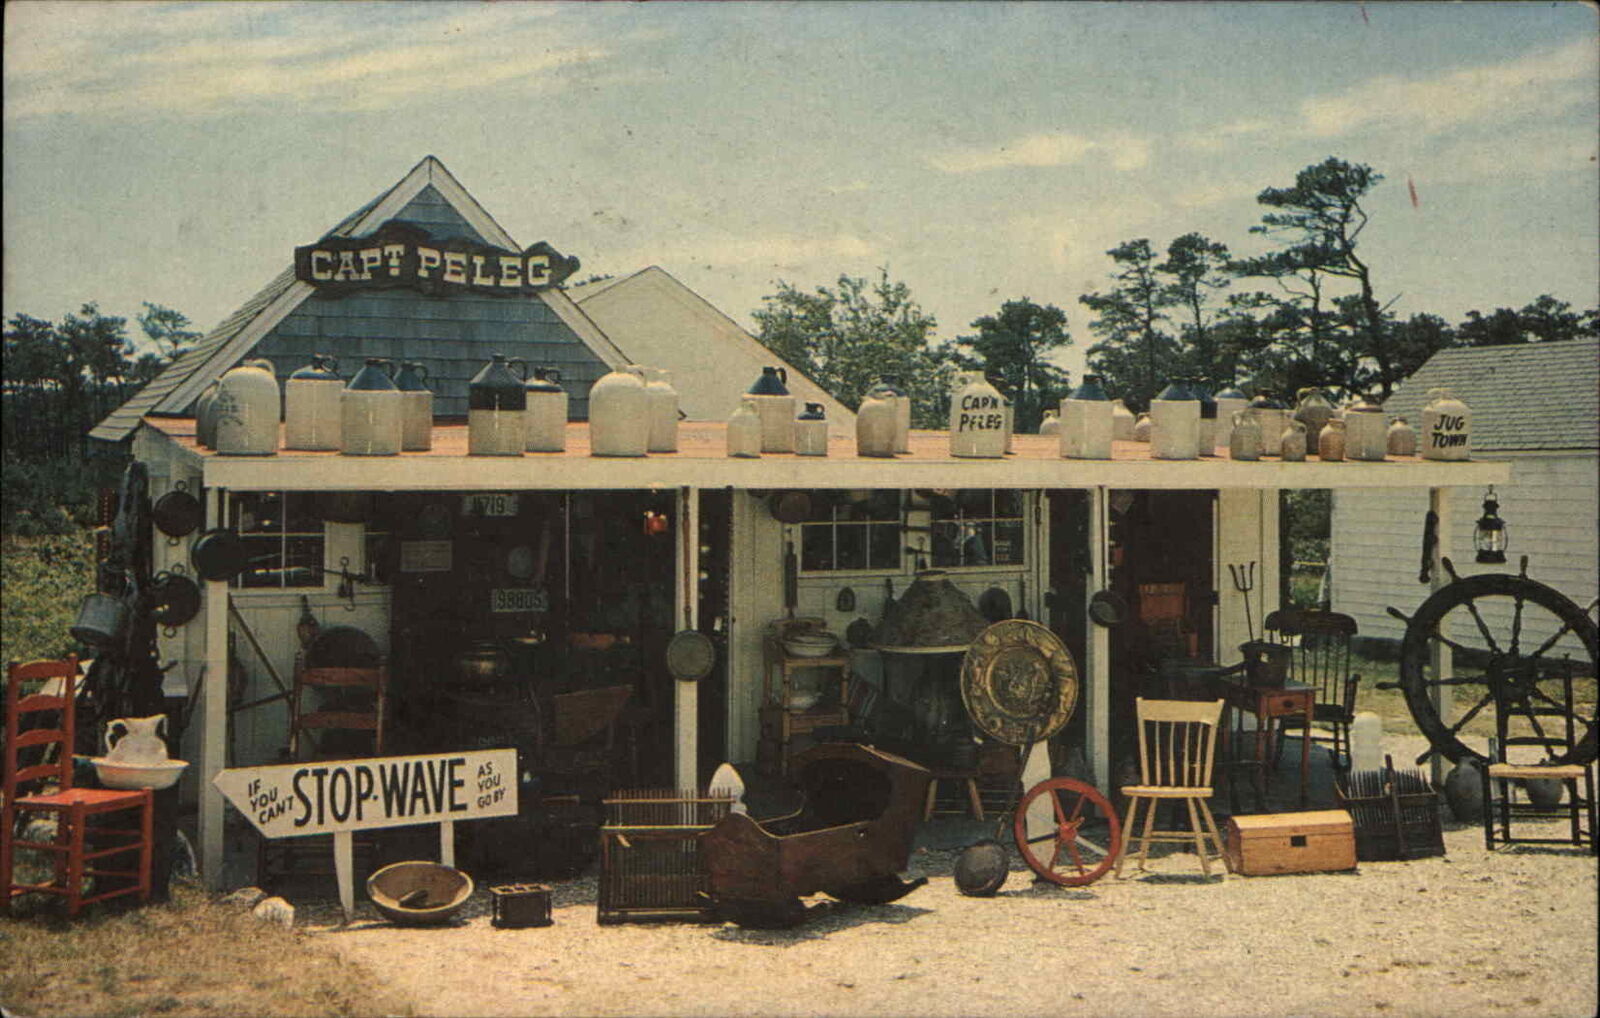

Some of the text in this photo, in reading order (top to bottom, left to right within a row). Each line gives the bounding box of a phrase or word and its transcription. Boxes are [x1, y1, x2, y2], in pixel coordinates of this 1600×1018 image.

[417, 246, 551, 287] PELEG
[1434, 414, 1465, 431] JUG
[1432, 432, 1468, 448] TOWN
[478, 761, 493, 778] AS
[248, 778, 261, 798] IF
[477, 773, 501, 792] YOU
[250, 786, 278, 812] YOU
[477, 787, 506, 808] GO BY
